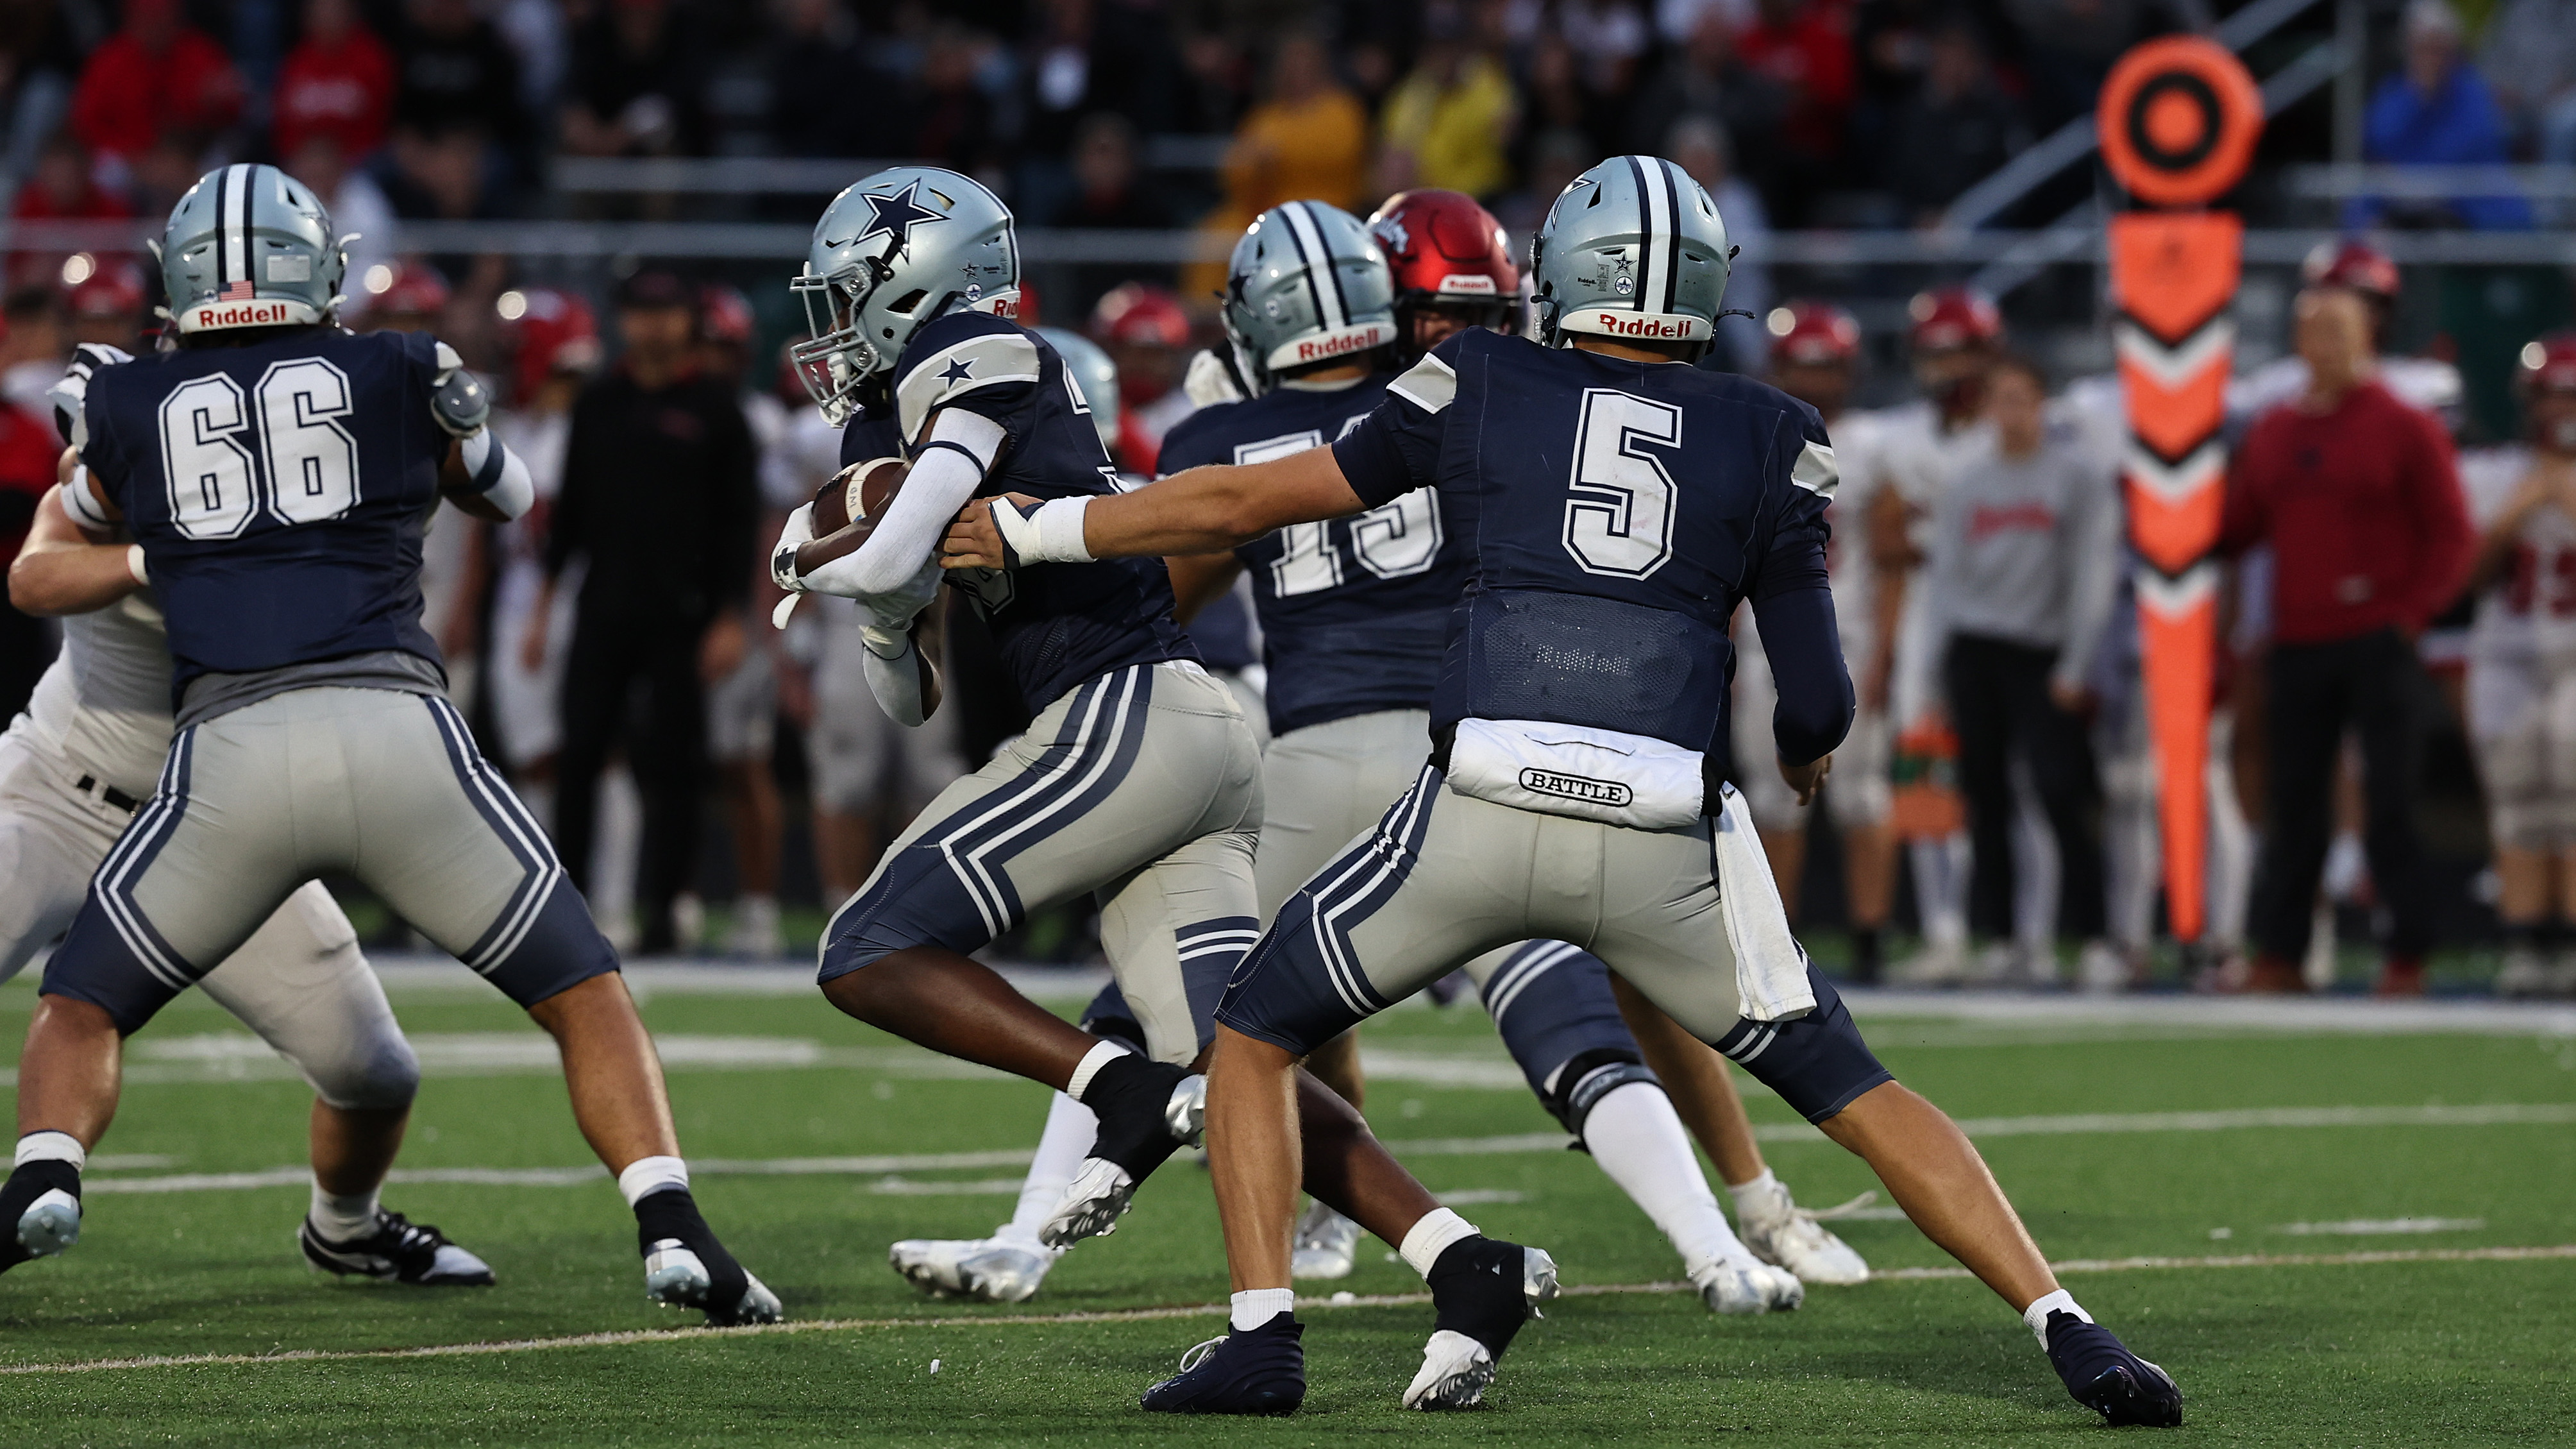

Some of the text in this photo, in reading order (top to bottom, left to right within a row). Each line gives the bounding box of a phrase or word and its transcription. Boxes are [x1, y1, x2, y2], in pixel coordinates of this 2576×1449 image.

[199, 303, 287, 328] Riddell
[1599, 314, 1692, 337] Riddell
[1297, 328, 1379, 360] Riddell
[158, 355, 362, 541] 66
[1561, 387, 1683, 581] 5
[1528, 772, 1622, 802] BATTLE
